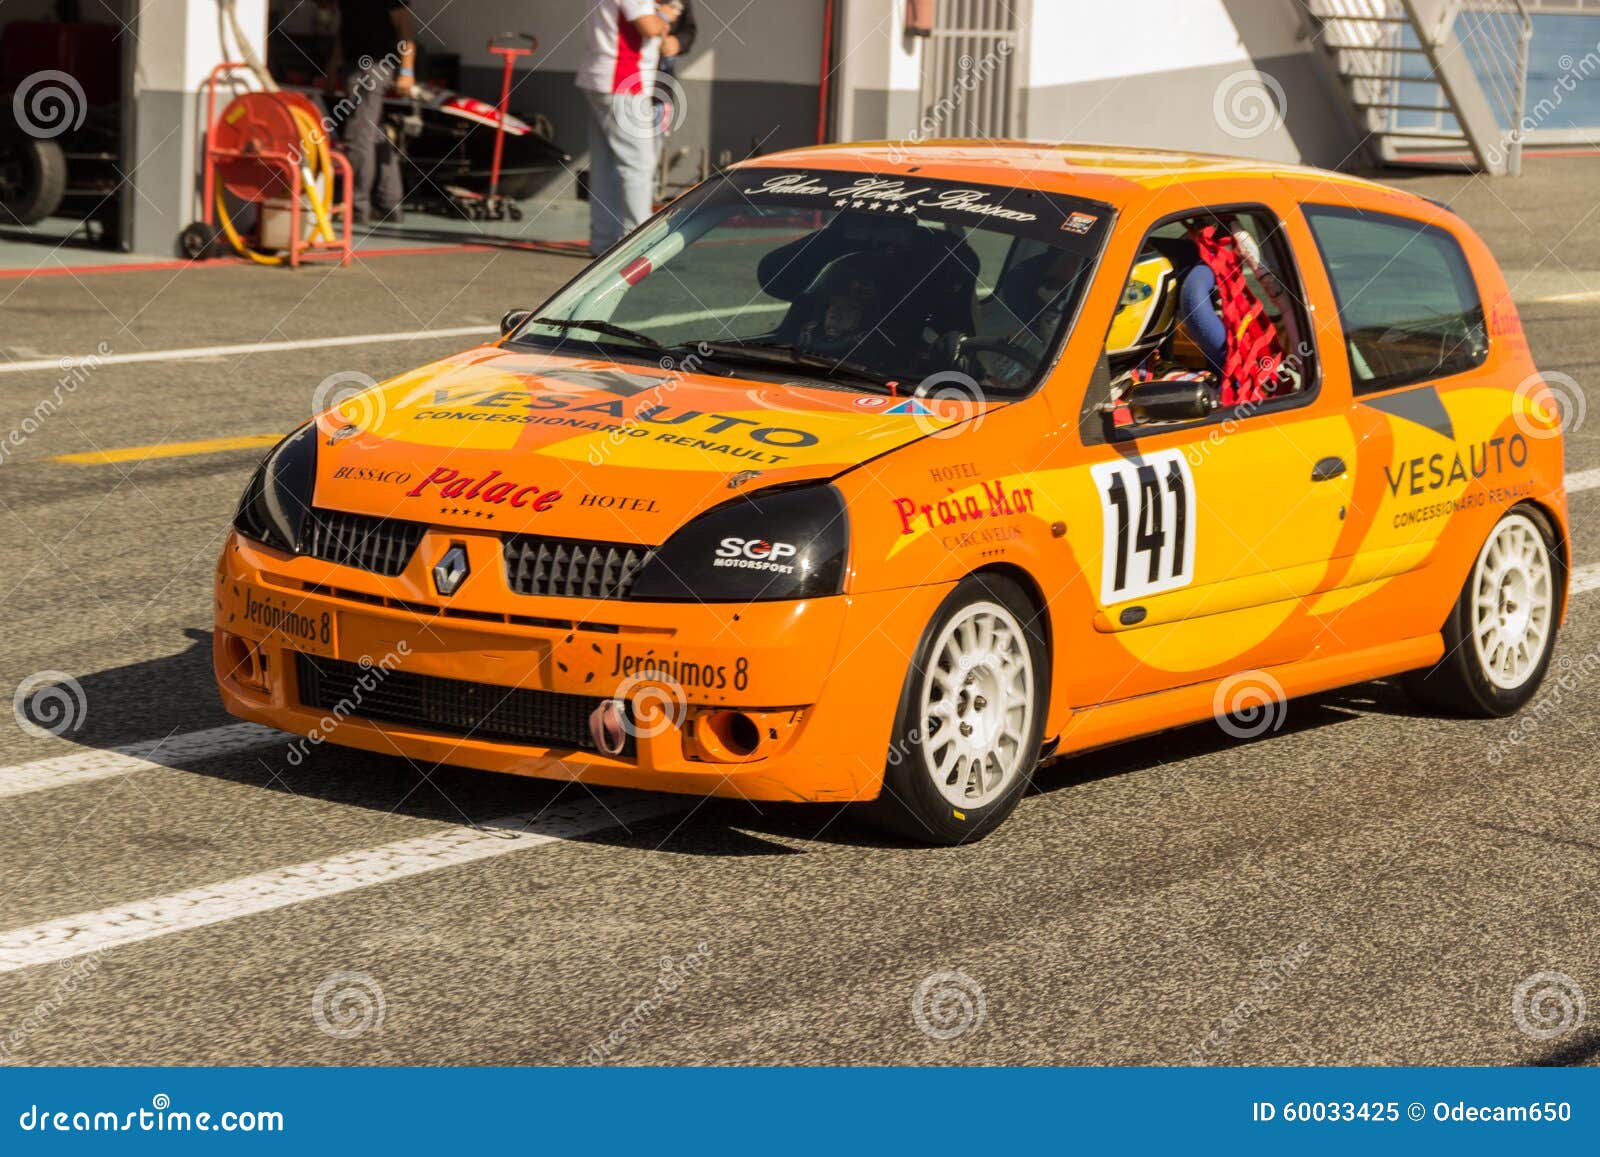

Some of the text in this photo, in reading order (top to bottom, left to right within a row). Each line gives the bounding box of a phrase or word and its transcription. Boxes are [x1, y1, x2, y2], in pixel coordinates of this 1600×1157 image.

[434, 390, 819, 448] VESAUTO
[654, 433, 788, 464] RENAULT
[930, 462, 981, 482] HOTEL
[1384, 433, 1527, 498] VESAUTO
[333, 466, 661, 513] BUSSACO Palace HOTEL
[981, 479, 1033, 517] Mar
[715, 537, 797, 561] SGP
[1108, 459, 1187, 592] 141
[713, 558, 795, 574] MOTORSPORT
[244, 588, 331, 645] Jerónimos 8
[611, 643, 749, 691] Jerónimos 8
